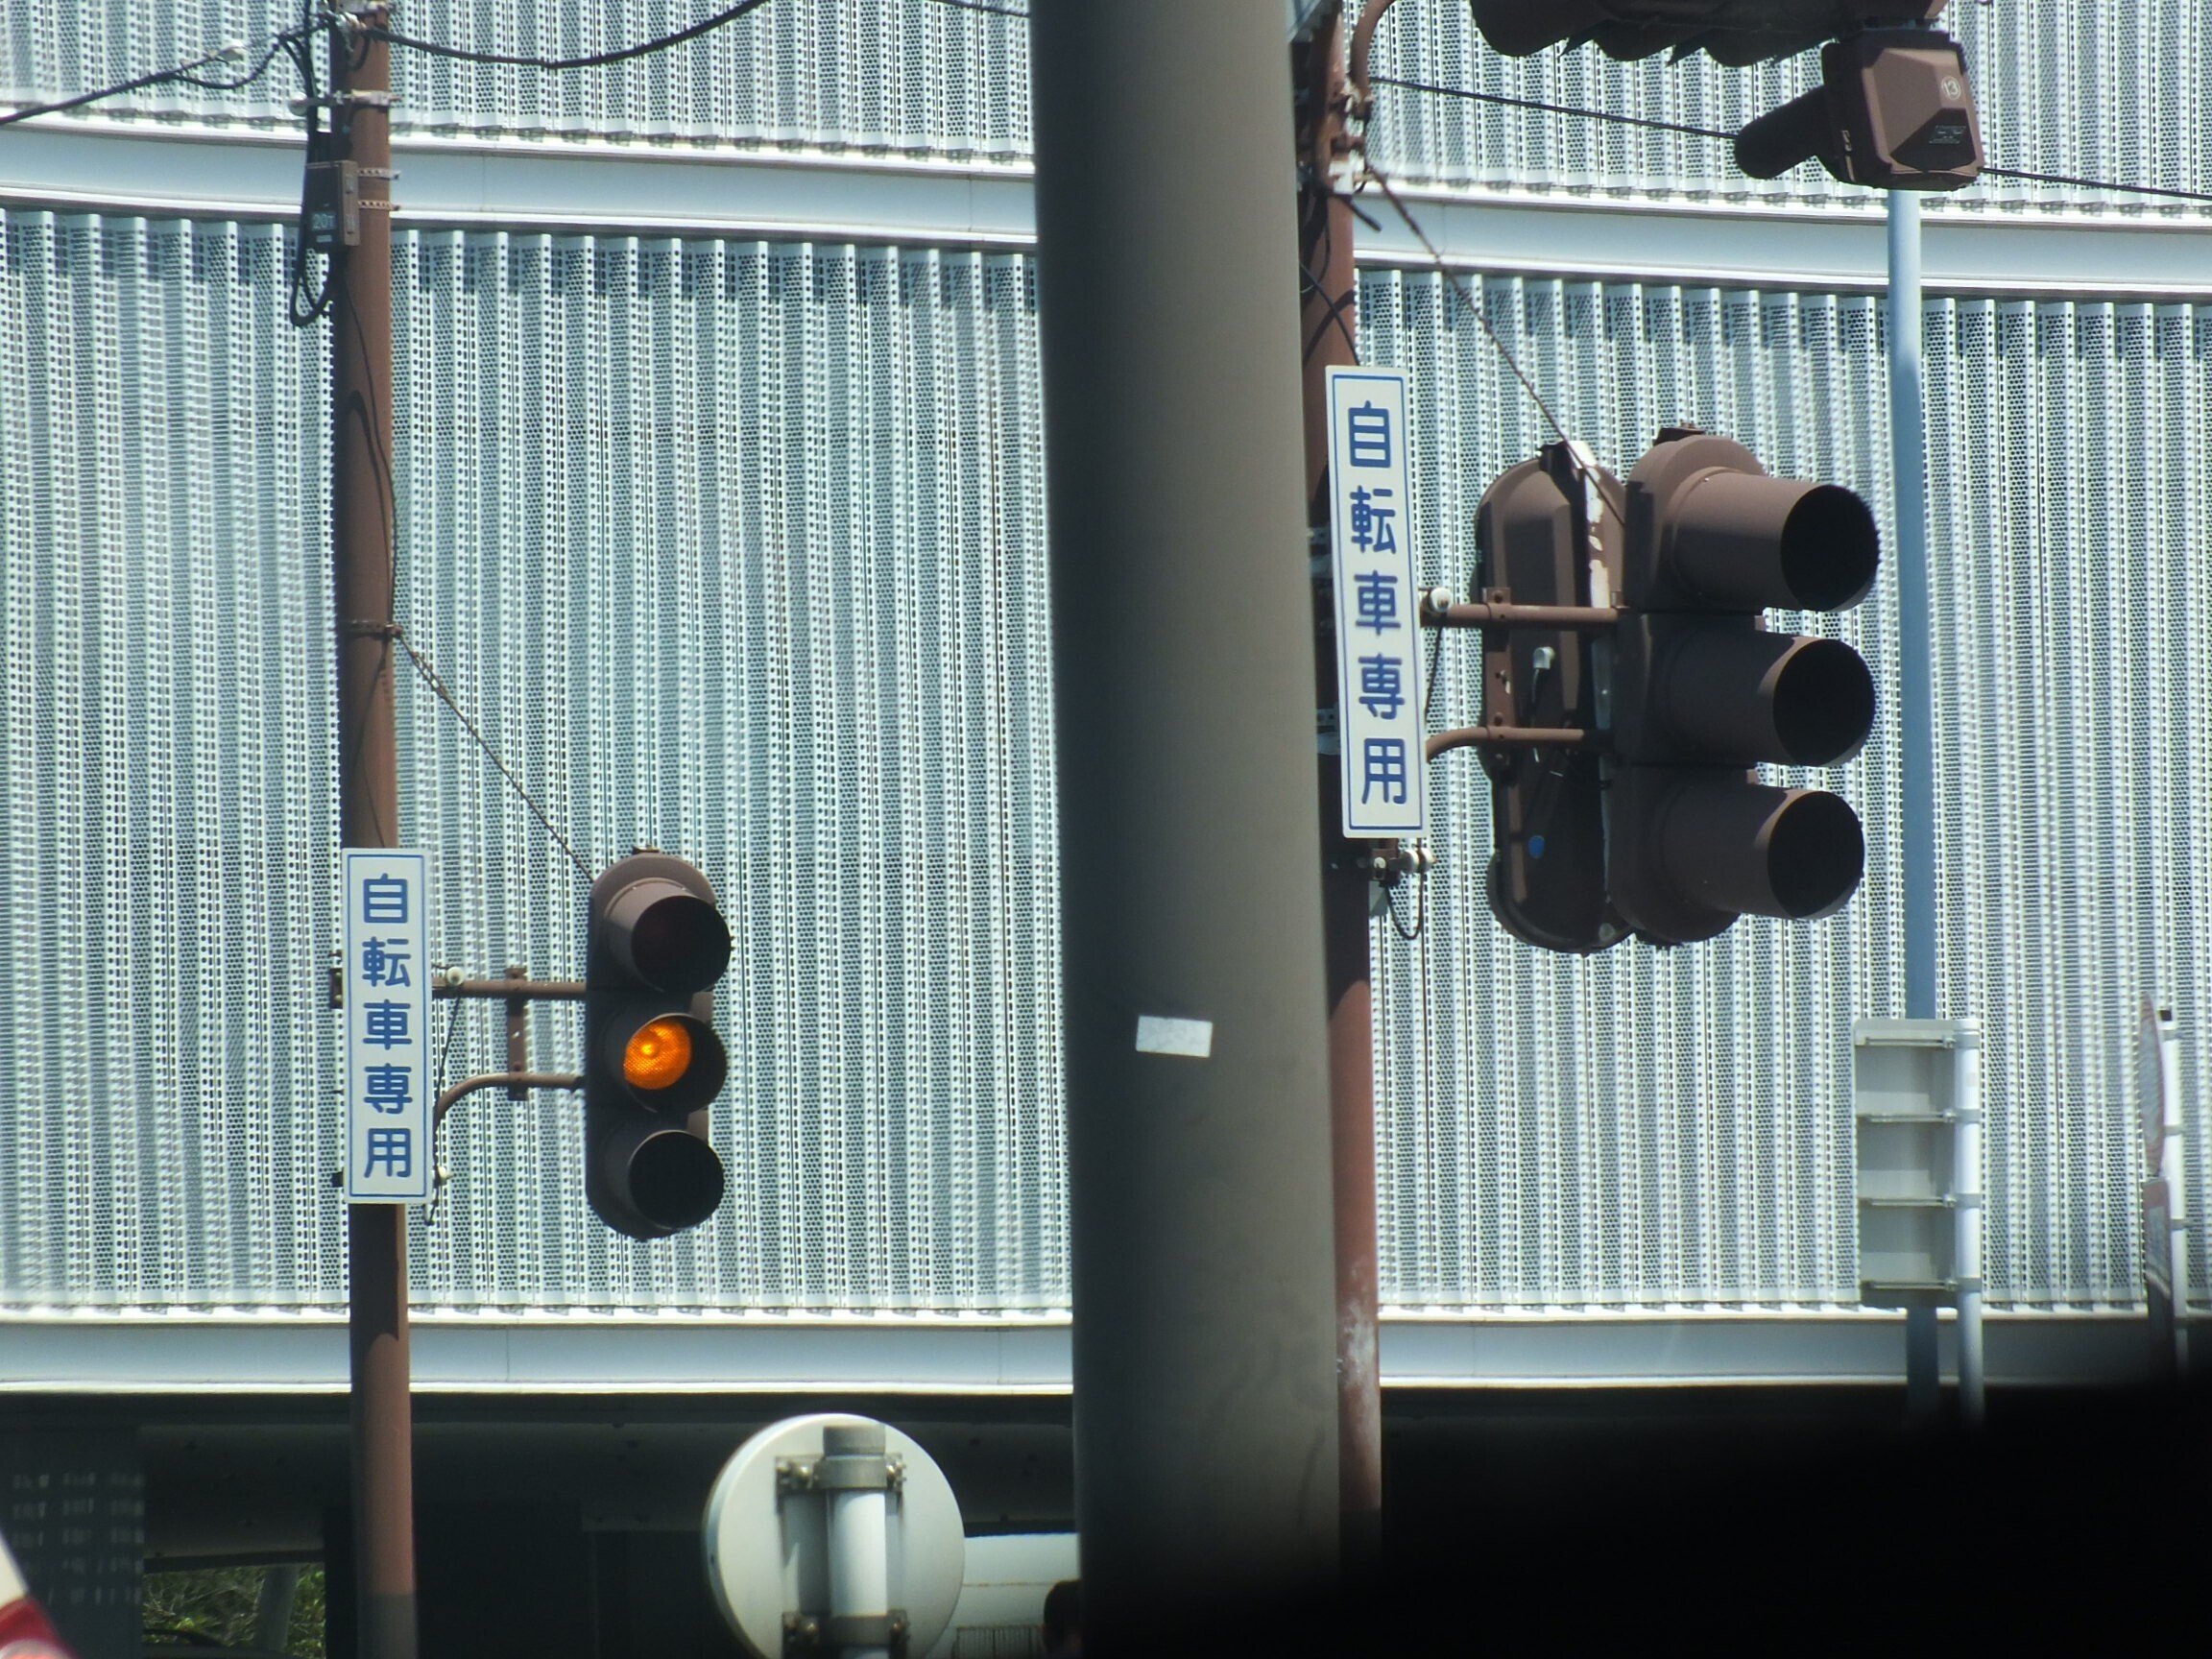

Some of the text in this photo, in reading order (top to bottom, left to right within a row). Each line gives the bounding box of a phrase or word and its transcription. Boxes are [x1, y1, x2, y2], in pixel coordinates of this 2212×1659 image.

[1943, 79, 1960, 97] 13
[1348, 400, 1407, 805] 自転車専用
[362, 873, 413, 1178] 自転車専用
